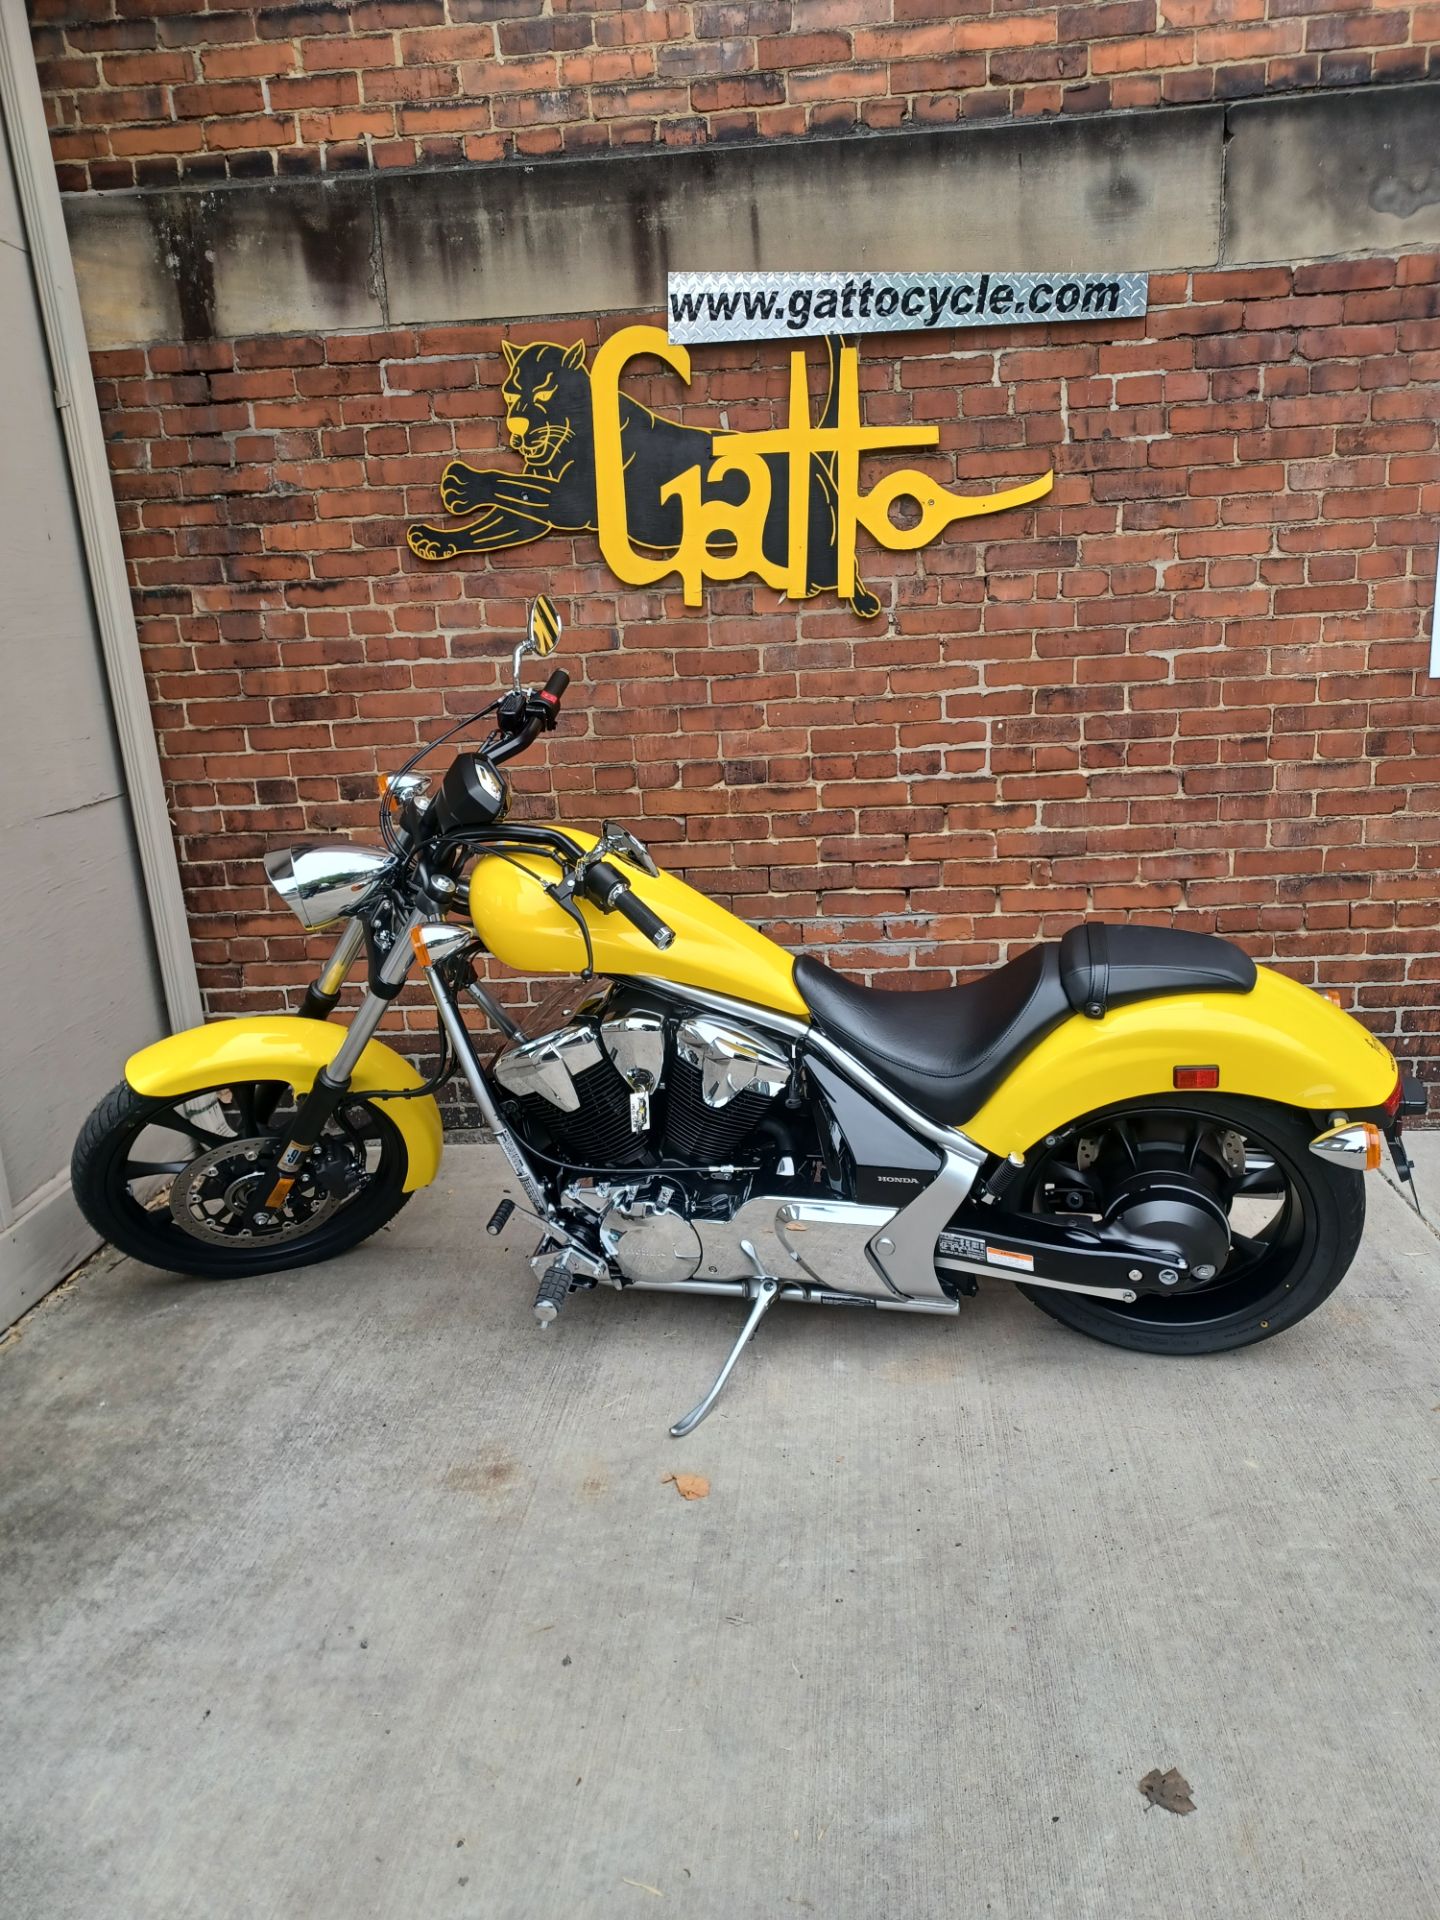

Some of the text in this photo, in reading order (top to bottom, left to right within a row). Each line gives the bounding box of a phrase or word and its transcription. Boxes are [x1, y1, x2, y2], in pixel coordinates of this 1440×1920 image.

[670, 275, 1120, 327] www.gattocycle.com
[591, 325, 1053, 606] Gatto
[877, 1176, 920, 1185] HONDA
